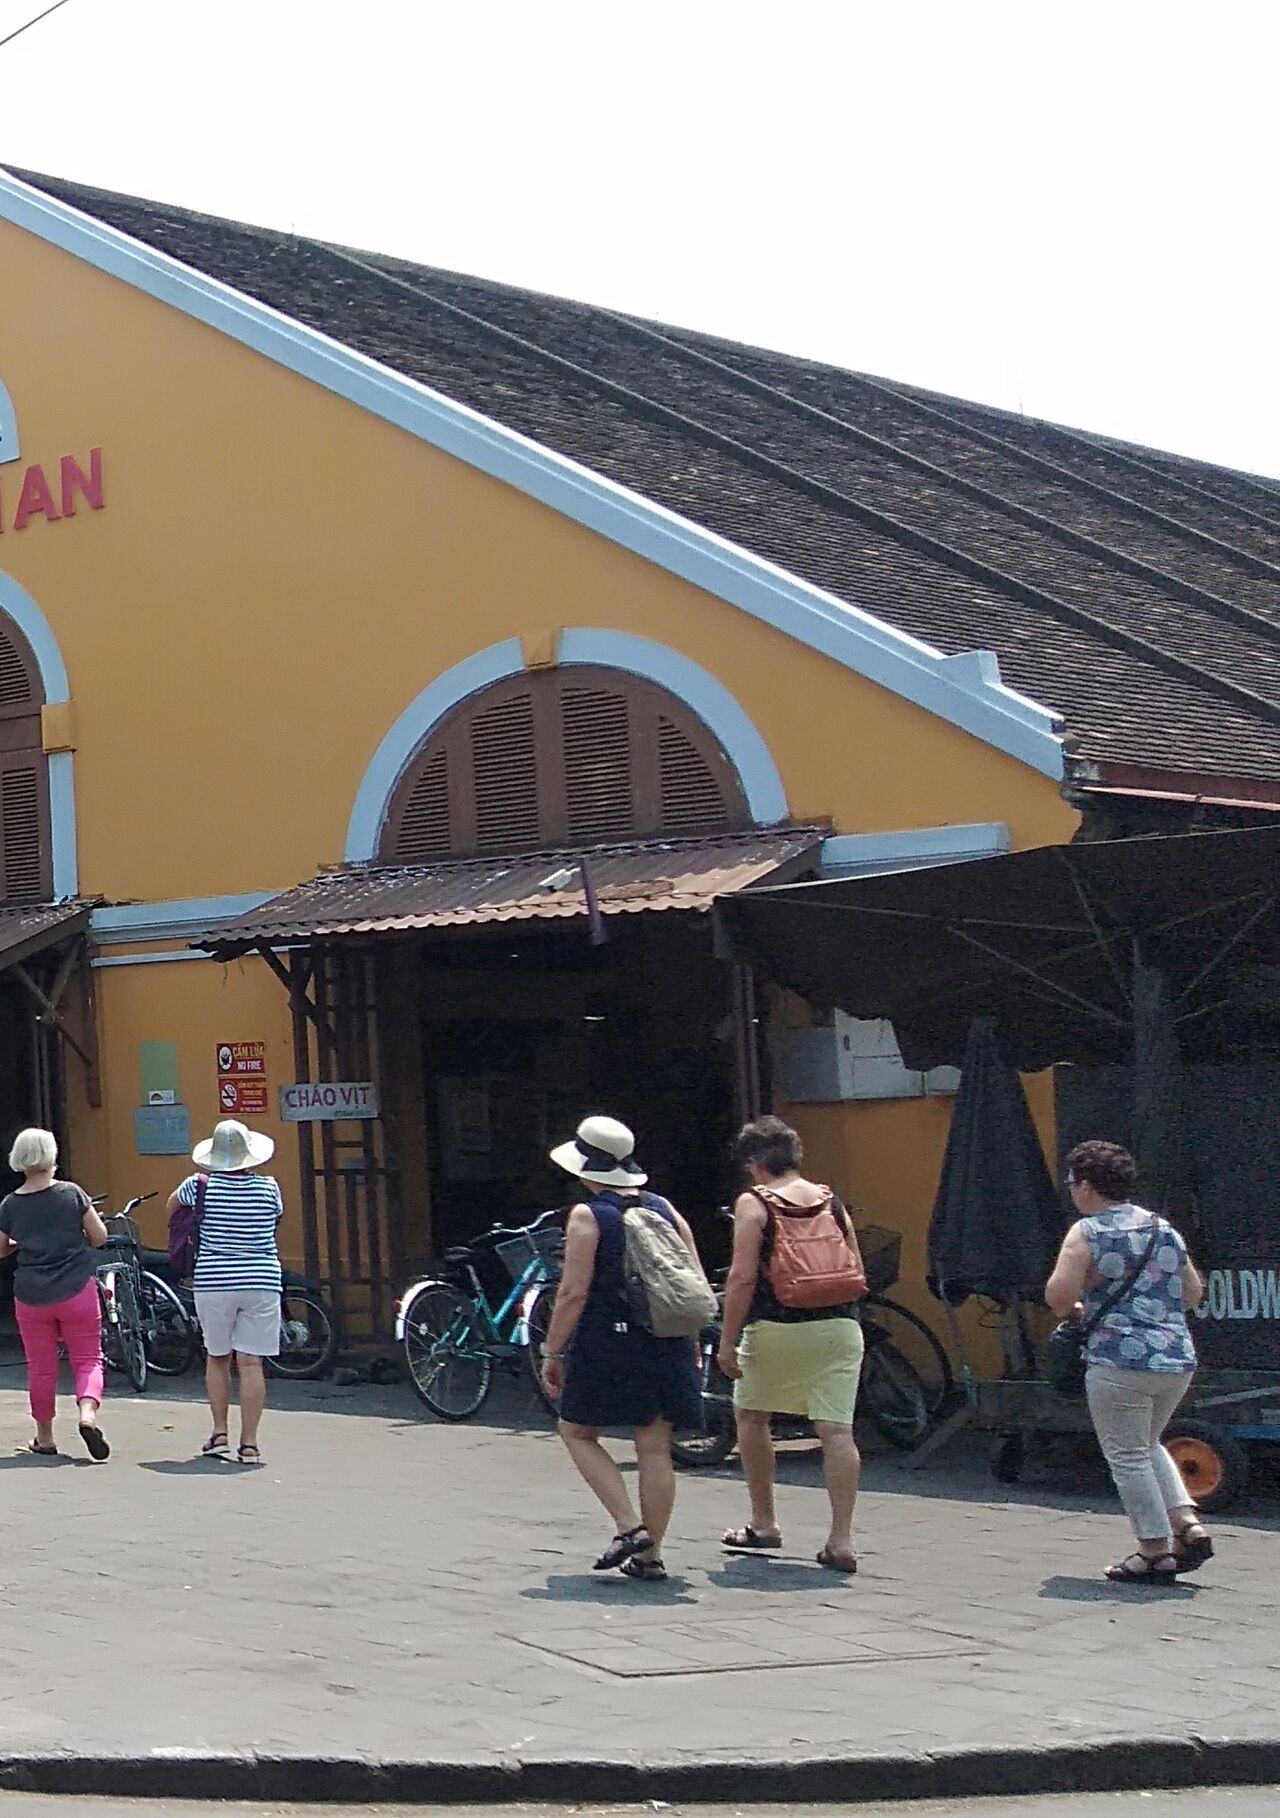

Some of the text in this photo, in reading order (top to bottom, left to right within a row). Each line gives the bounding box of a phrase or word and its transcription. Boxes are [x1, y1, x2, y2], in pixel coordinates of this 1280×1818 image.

[13, 447, 105, 530] AN
[285, 1084, 370, 1109] CHÁO VỊT
